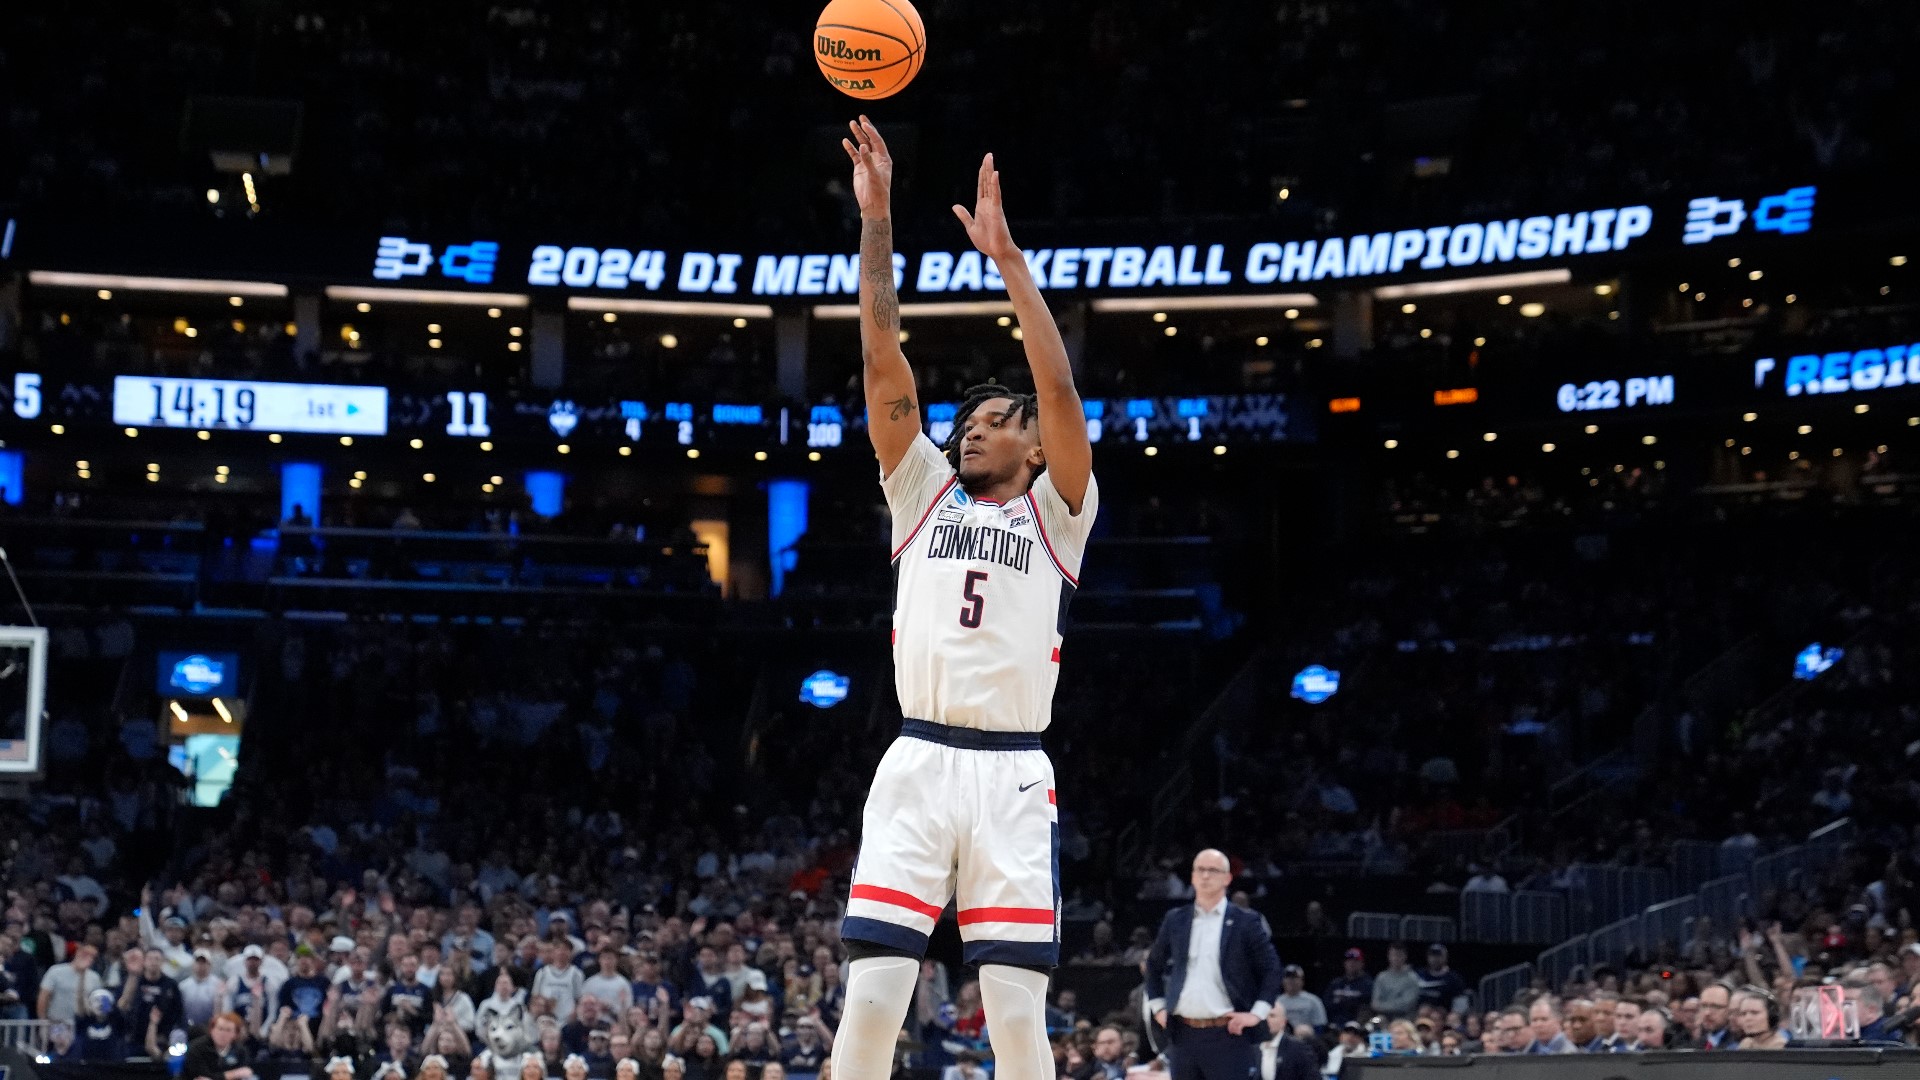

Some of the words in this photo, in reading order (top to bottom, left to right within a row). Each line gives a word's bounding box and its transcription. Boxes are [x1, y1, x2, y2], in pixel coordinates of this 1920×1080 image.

[817, 35, 882, 61] Wilson
[827, 73, 876, 90] NCAA
[528, 245, 666, 290] 2024
[678, 252, 743, 294] DI
[1244, 205, 1653, 284] CHAMPIONSHIP
[13, 373, 42, 419] 5
[152, 384, 255, 424] 14:19
[1557, 380, 1620, 412] 6:22
[1625, 375, 1674, 407] PM
[307, 397, 336, 418] 1st
[446, 391, 491, 437] 11
[625, 418, 641, 441] 4
[678, 421, 693, 444] 2
[807, 423, 842, 447] 100
[1135, 417, 1149, 441] 1
[1187, 416, 1202, 441] 1
[928, 524, 1034, 575] CONNECTICUT
[959, 570, 988, 628] 5
